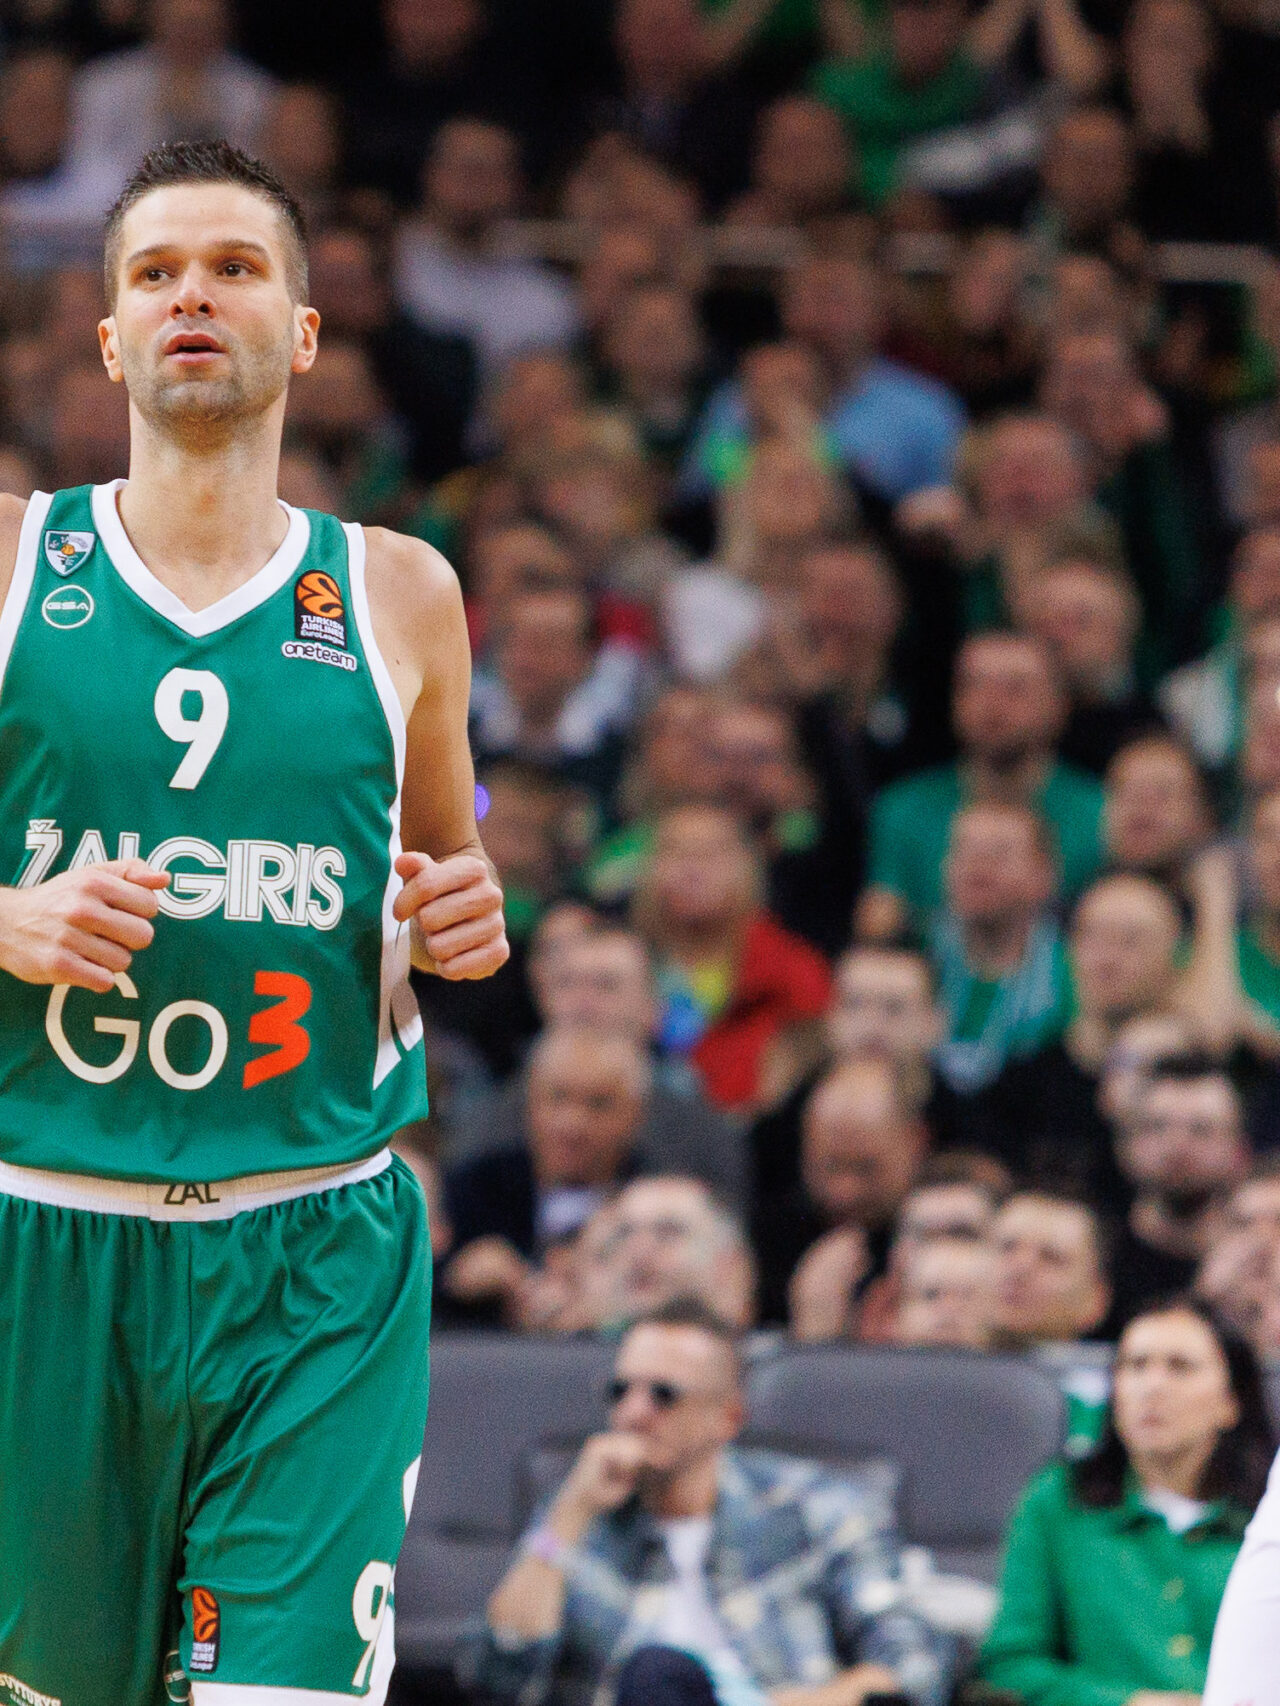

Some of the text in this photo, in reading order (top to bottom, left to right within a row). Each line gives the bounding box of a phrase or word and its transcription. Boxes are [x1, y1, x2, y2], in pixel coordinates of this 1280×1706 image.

[284, 643, 355, 669] oneteam
[154, 667, 229, 790] 9
[352, 1560, 393, 1688] 9
